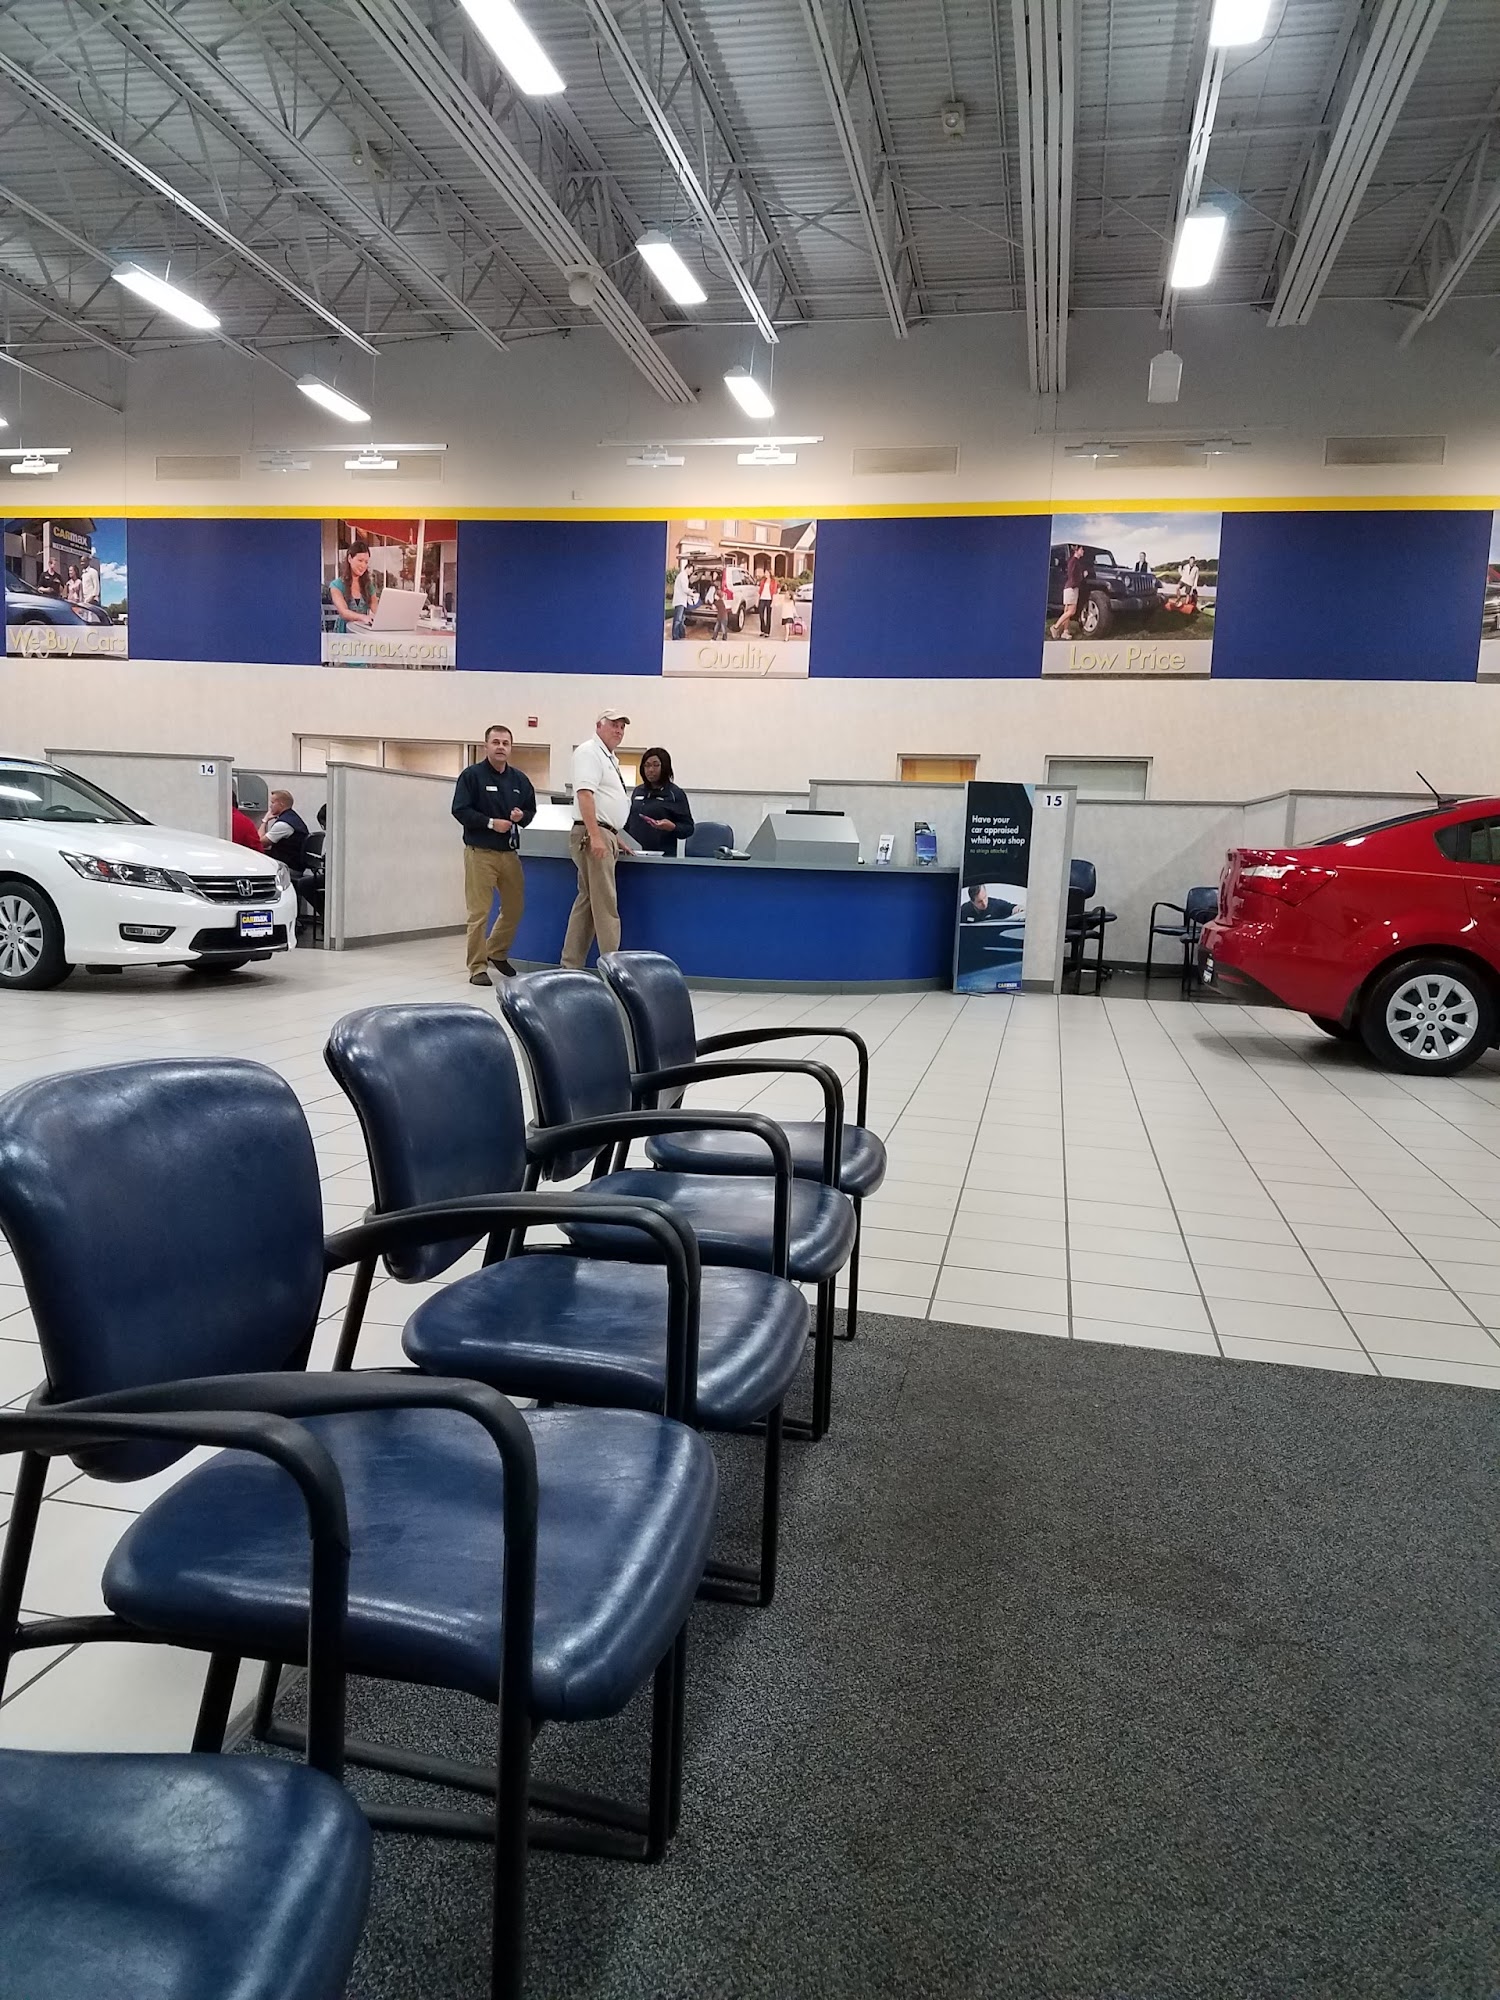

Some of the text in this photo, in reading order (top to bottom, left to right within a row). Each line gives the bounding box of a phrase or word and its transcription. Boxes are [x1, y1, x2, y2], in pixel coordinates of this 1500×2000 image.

[9, 627, 125, 657] We Buy Cars
[329, 642, 448, 659] carmax.com
[698, 643, 777, 676] Quality
[1069, 645, 1185, 671] Low Price
[201, 764, 214, 774] 14
[1046, 795, 1062, 806] 15
[972, 815, 1010, 825] Have your
[984, 825, 1019, 836] appraised
[971, 836, 1025, 846] while you shop
